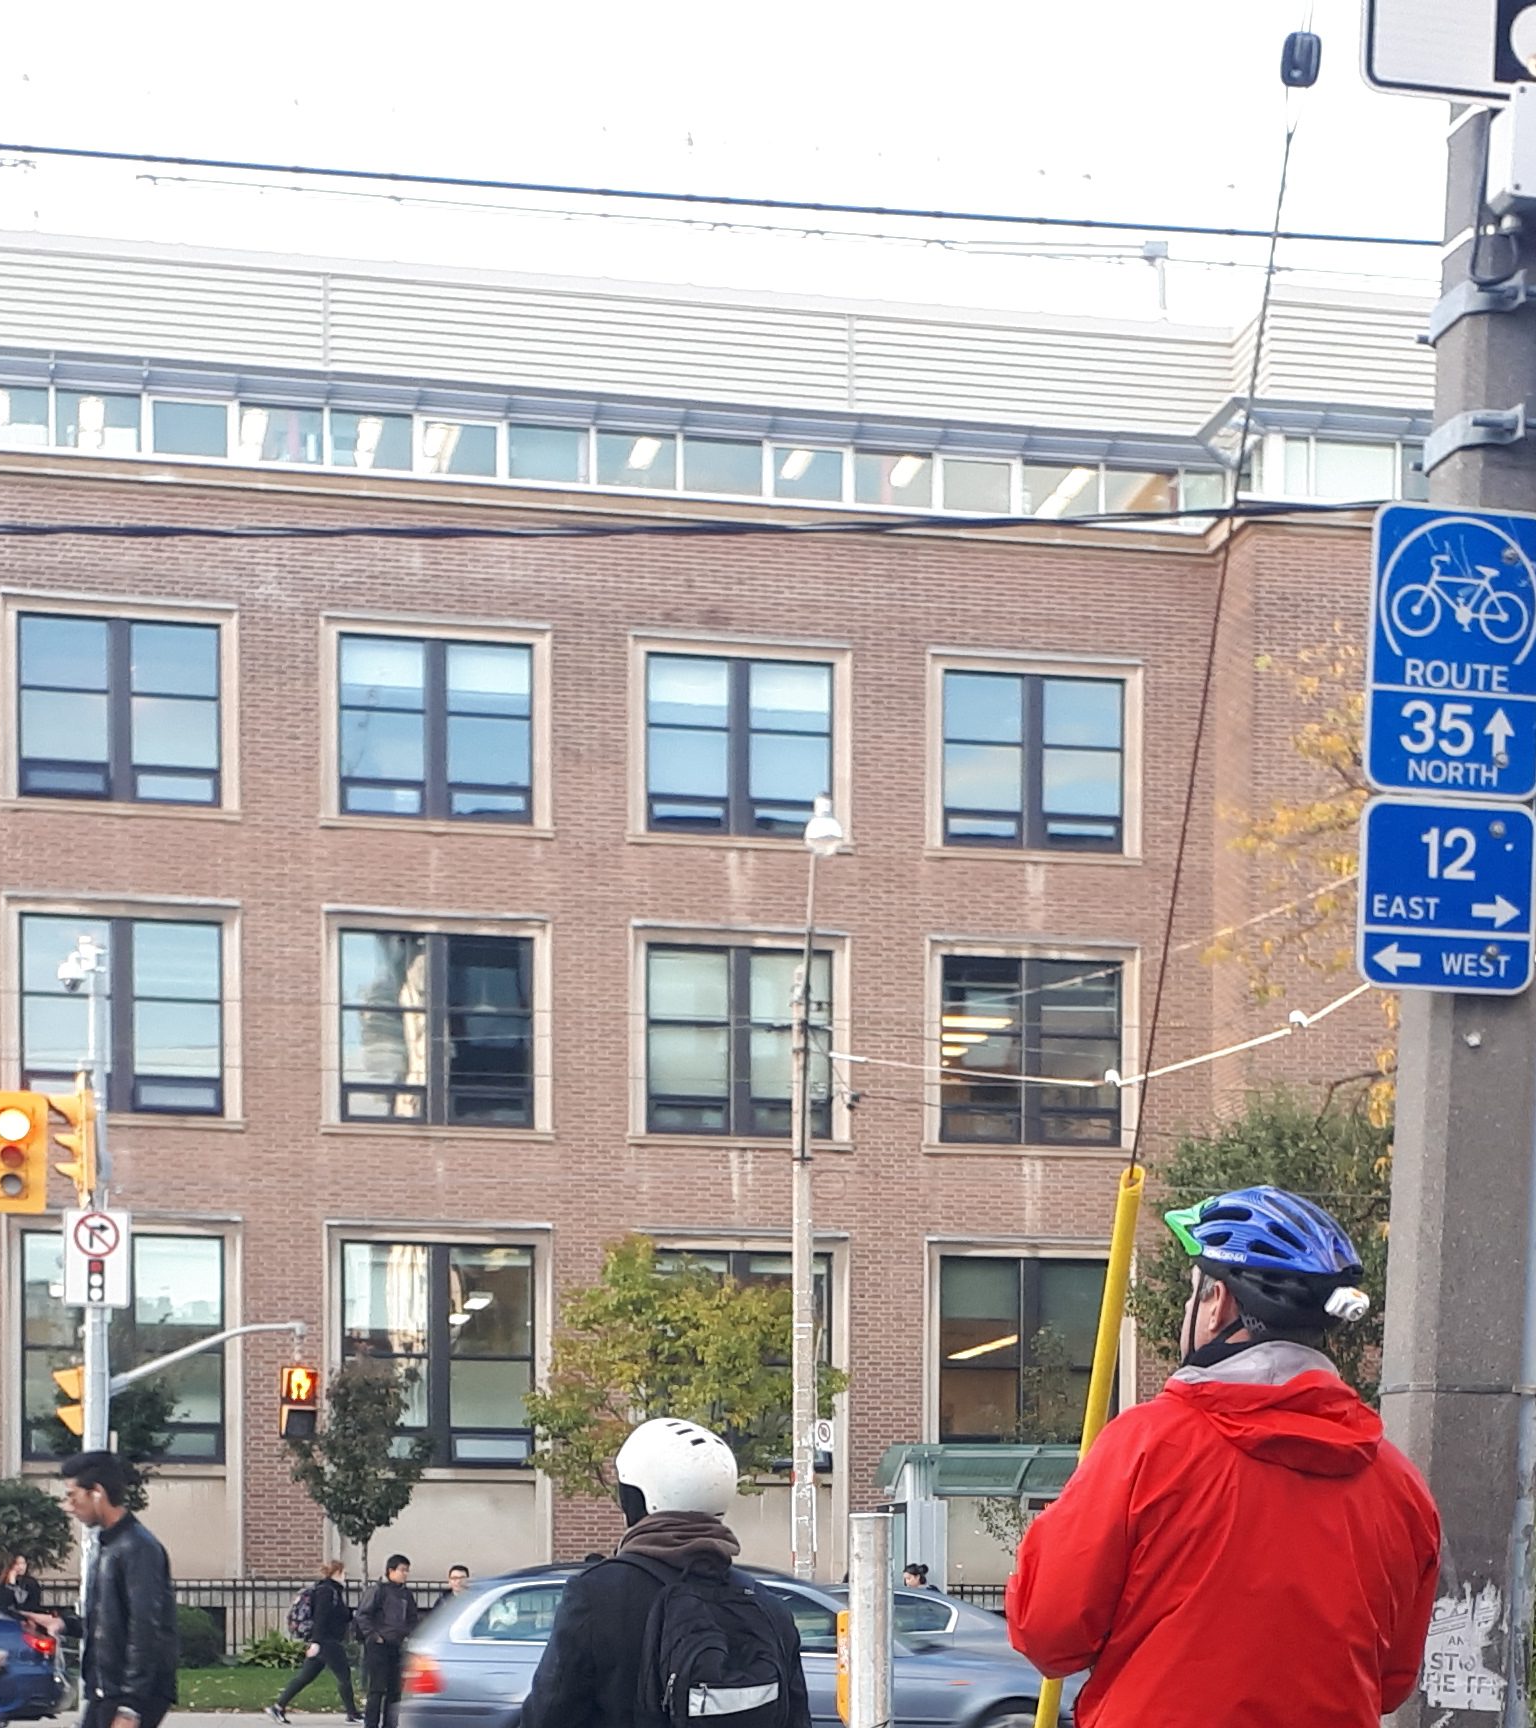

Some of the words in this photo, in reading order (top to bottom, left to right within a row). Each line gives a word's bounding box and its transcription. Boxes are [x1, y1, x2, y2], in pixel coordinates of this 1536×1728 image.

[1404, 657, 1509, 693] ROUTE
[1399, 700, 1475, 756] 35
[1408, 757, 1498, 788] NORTH
[1421, 826, 1477, 881] 12
[1372, 895, 1440, 921] EAST
[1441, 951, 1511, 977] WEST
